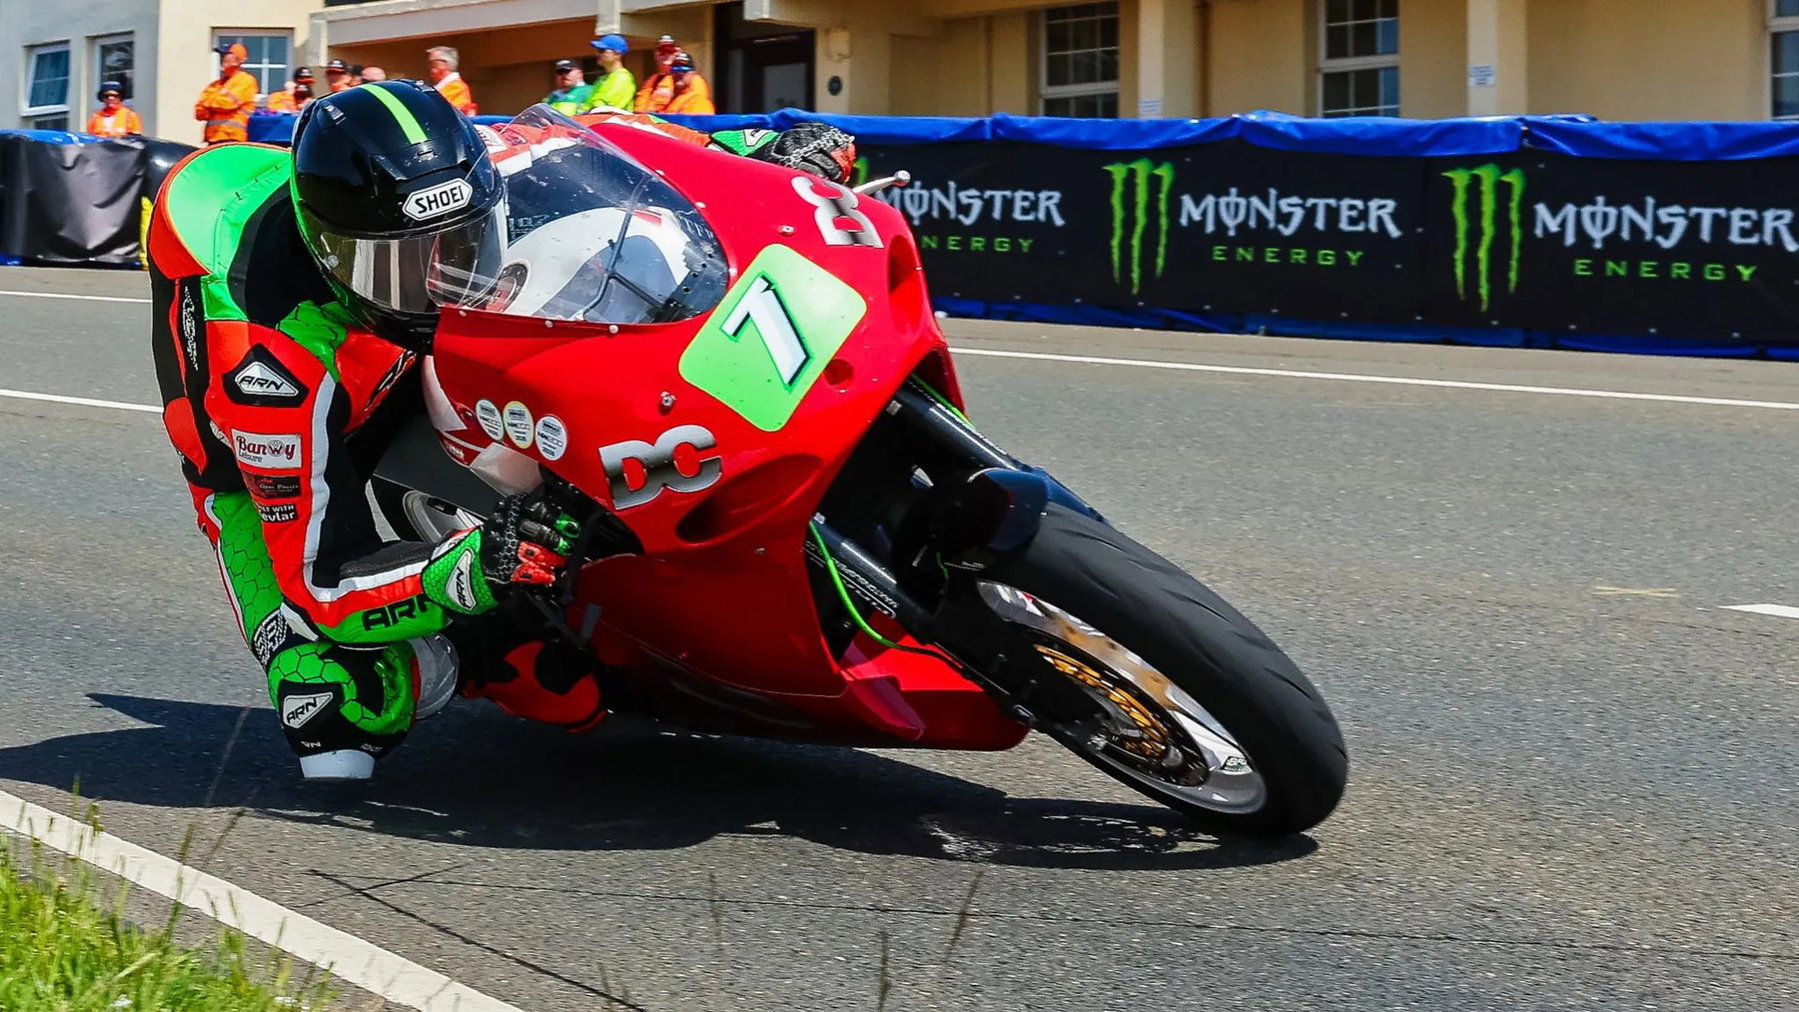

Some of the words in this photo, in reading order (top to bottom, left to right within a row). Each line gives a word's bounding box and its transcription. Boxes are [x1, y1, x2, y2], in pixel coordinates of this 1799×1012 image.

[414, 185, 464, 214] SHOEI
[790, 175, 885, 249] DC
[1179, 187, 1403, 239] MONSTER
[1533, 195, 1799, 253] MONSTER
[920, 235, 1034, 252] NERGY
[1211, 245, 1364, 266] ENERGY
[1573, 258, 1758, 282] ENERGY
[719, 273, 812, 387] 7
[240, 375, 284, 391] ARN
[598, 424, 723, 511] DC
[261, 511, 295, 521] evlar
[271, 503, 295, 513] WITH
[456, 566, 470, 607] ARN
[286, 696, 319, 725] ARN
